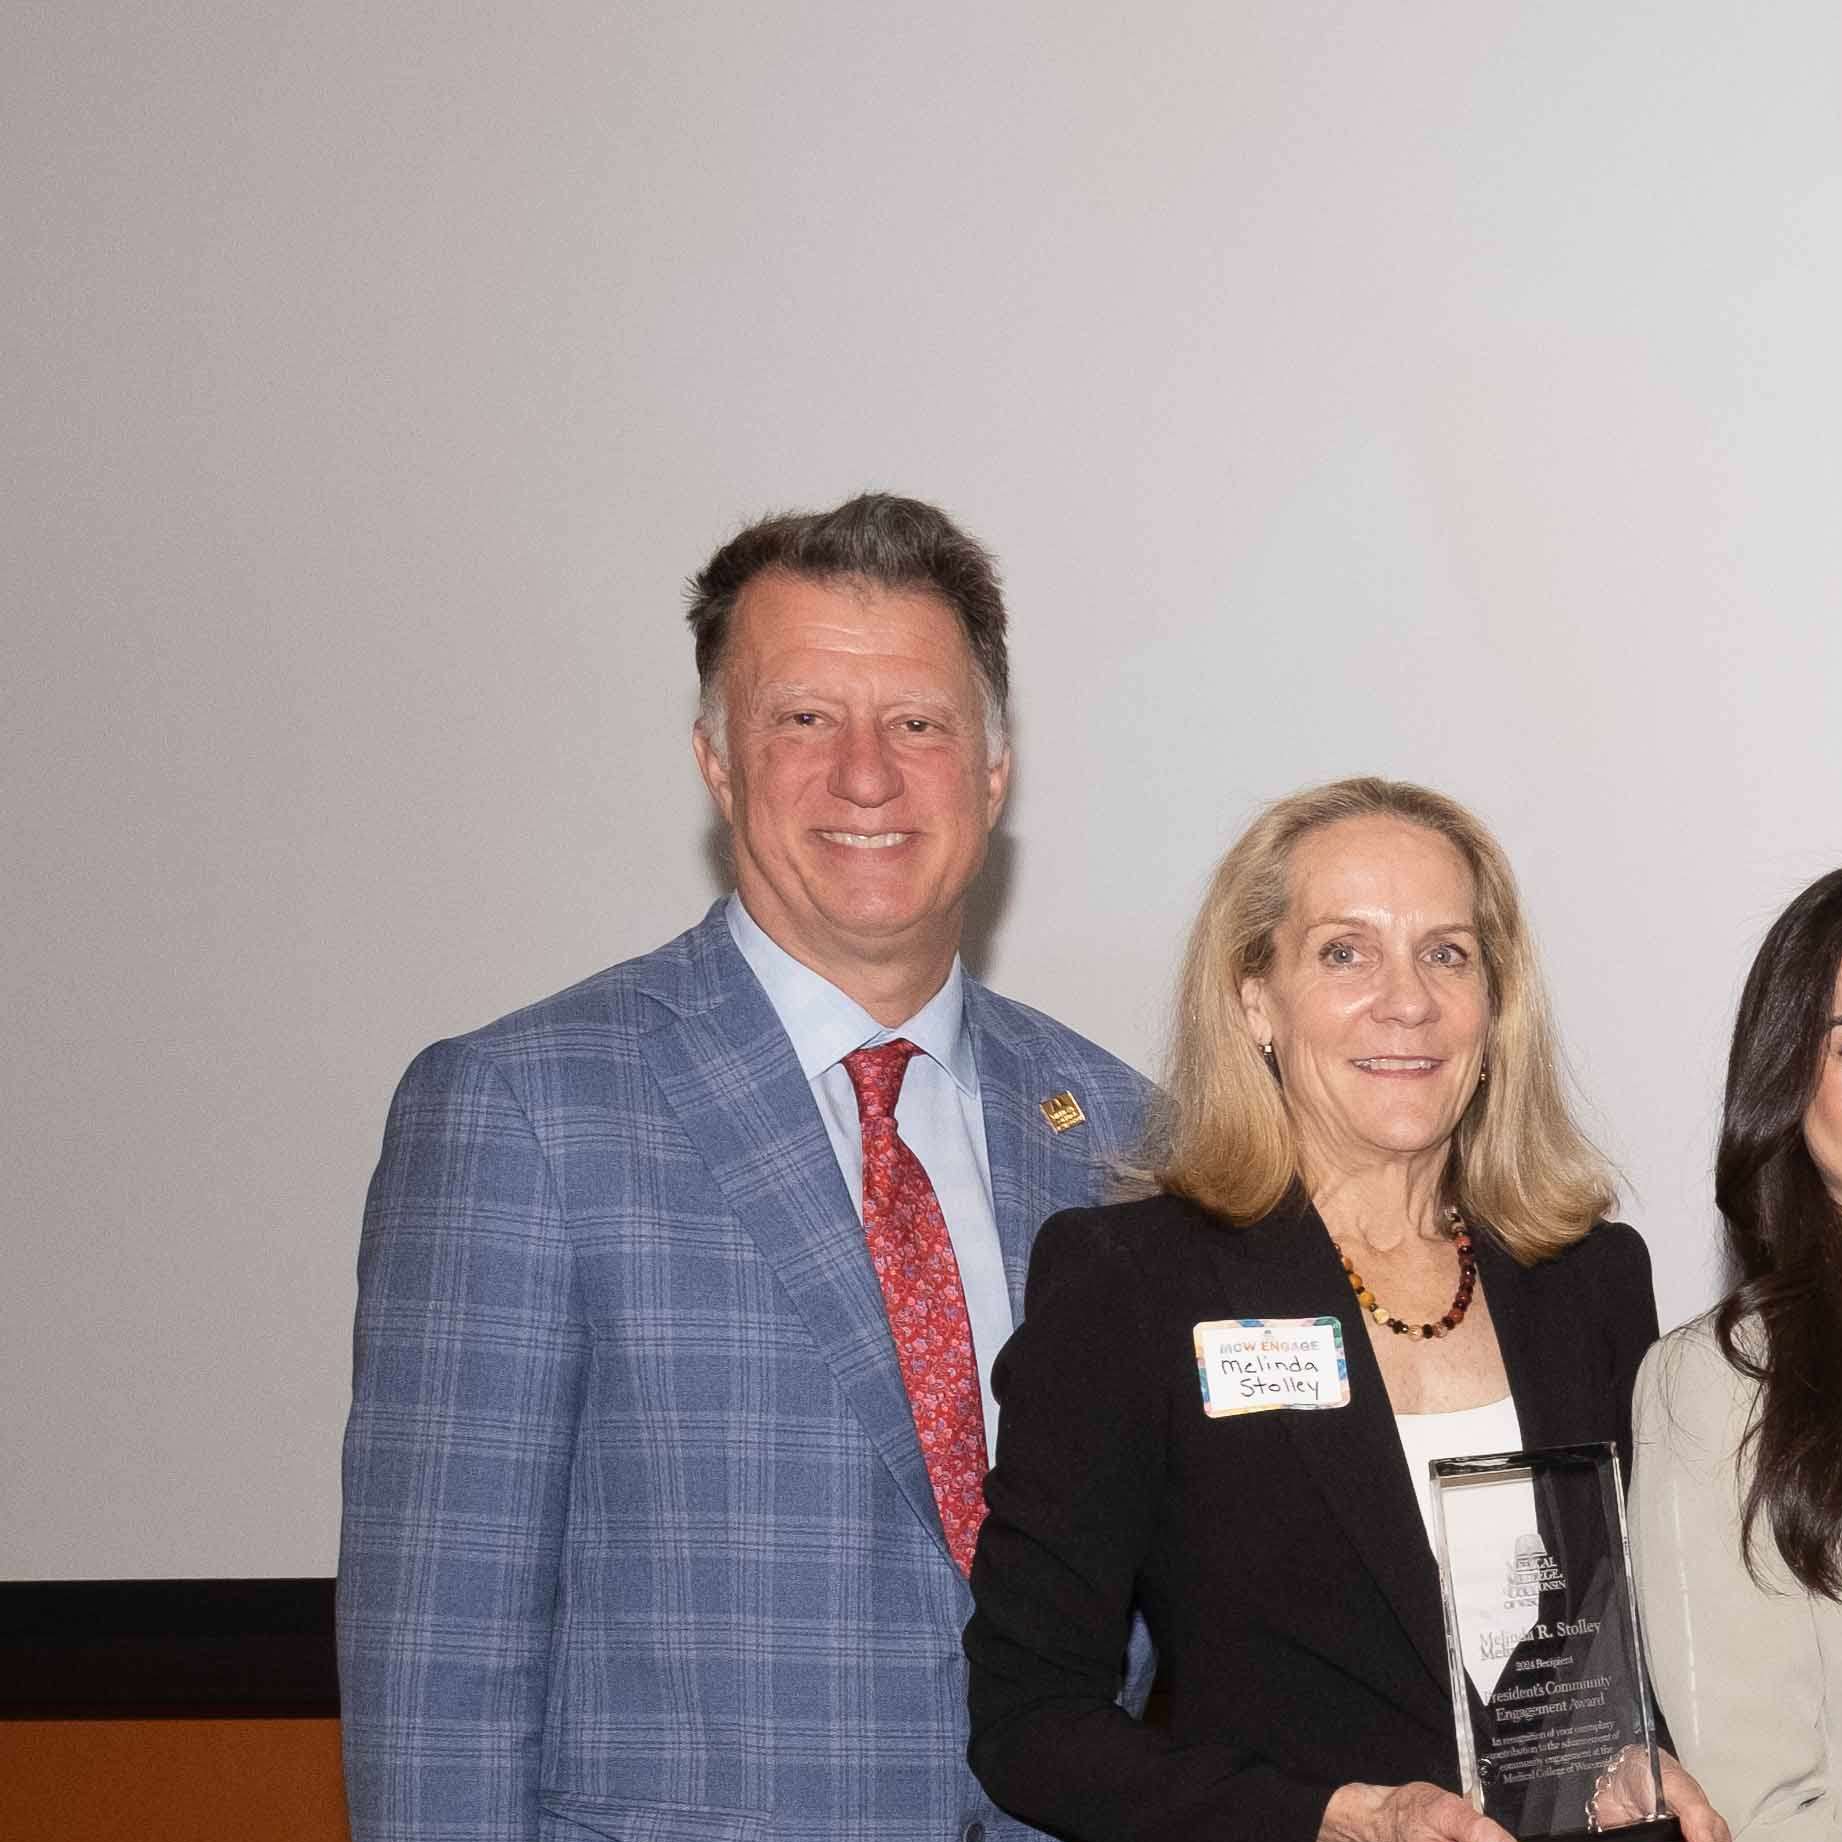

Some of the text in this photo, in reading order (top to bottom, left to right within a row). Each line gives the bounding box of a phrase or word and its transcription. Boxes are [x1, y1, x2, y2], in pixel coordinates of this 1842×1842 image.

[1260, 1340, 1320, 1352] ENGAGE
[1221, 1355, 1319, 1374] Melinda
[1240, 1376, 1319, 1400] Stolley
[1535, 1624, 1554, 1640] R.
[1556, 1618, 1600, 1637] Stolley
[1545, 1676, 1611, 1695] Community
[1495, 1691, 1606, 1722] Engagement Award
